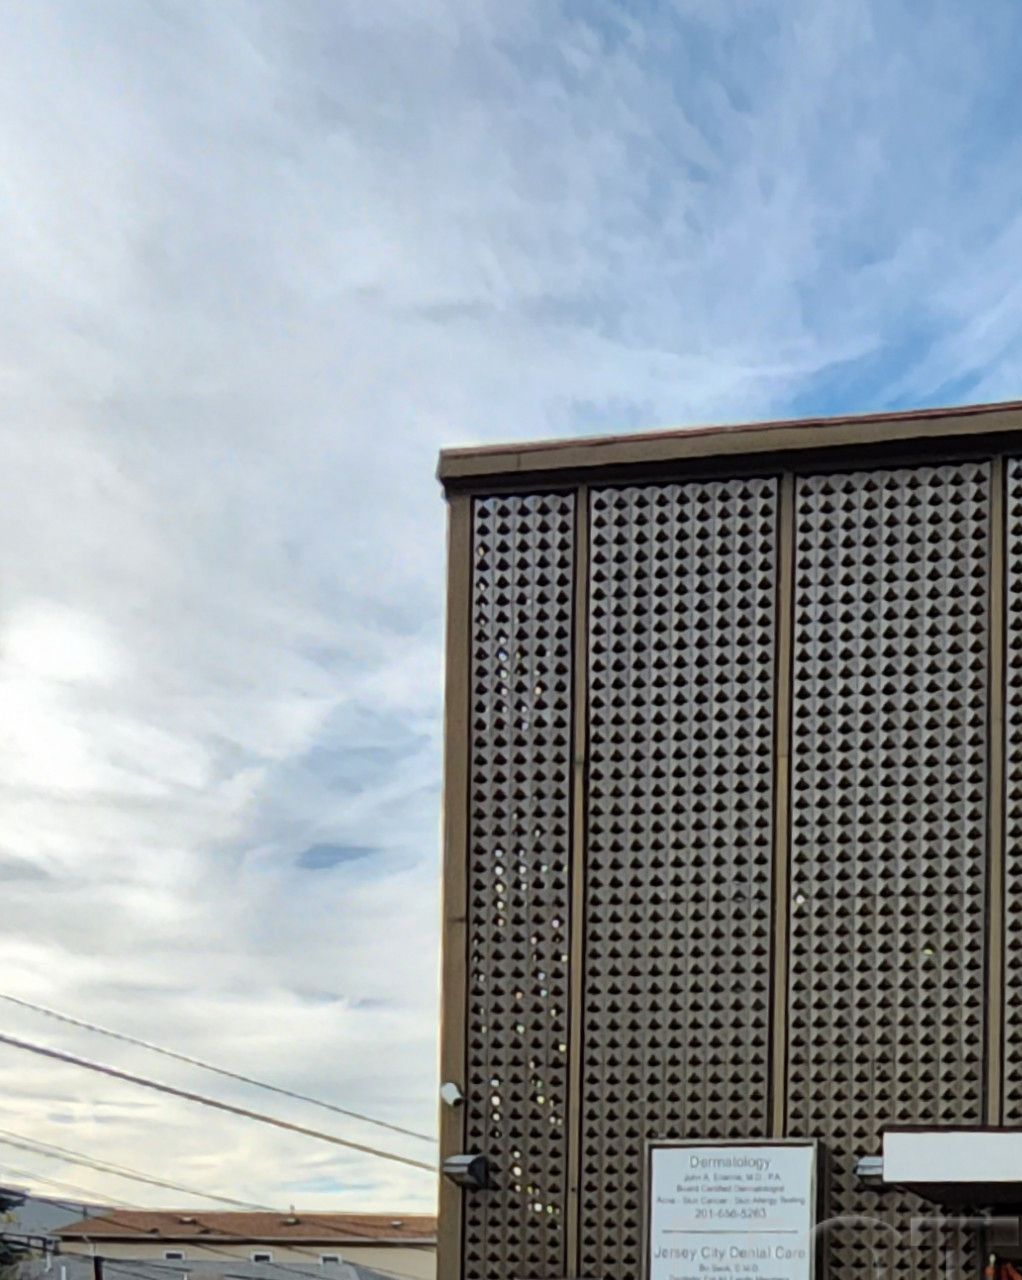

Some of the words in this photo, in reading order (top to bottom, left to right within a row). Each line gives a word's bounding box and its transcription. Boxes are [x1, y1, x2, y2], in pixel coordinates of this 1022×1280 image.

[689, 1155, 771, 1170] Dermatology
[654, 1247, 697, 1261] Jersey
[700, 1246, 725, 1261] City
[729, 1246, 772, 1259] Dental
[775, 1246, 806, 1260] Care
